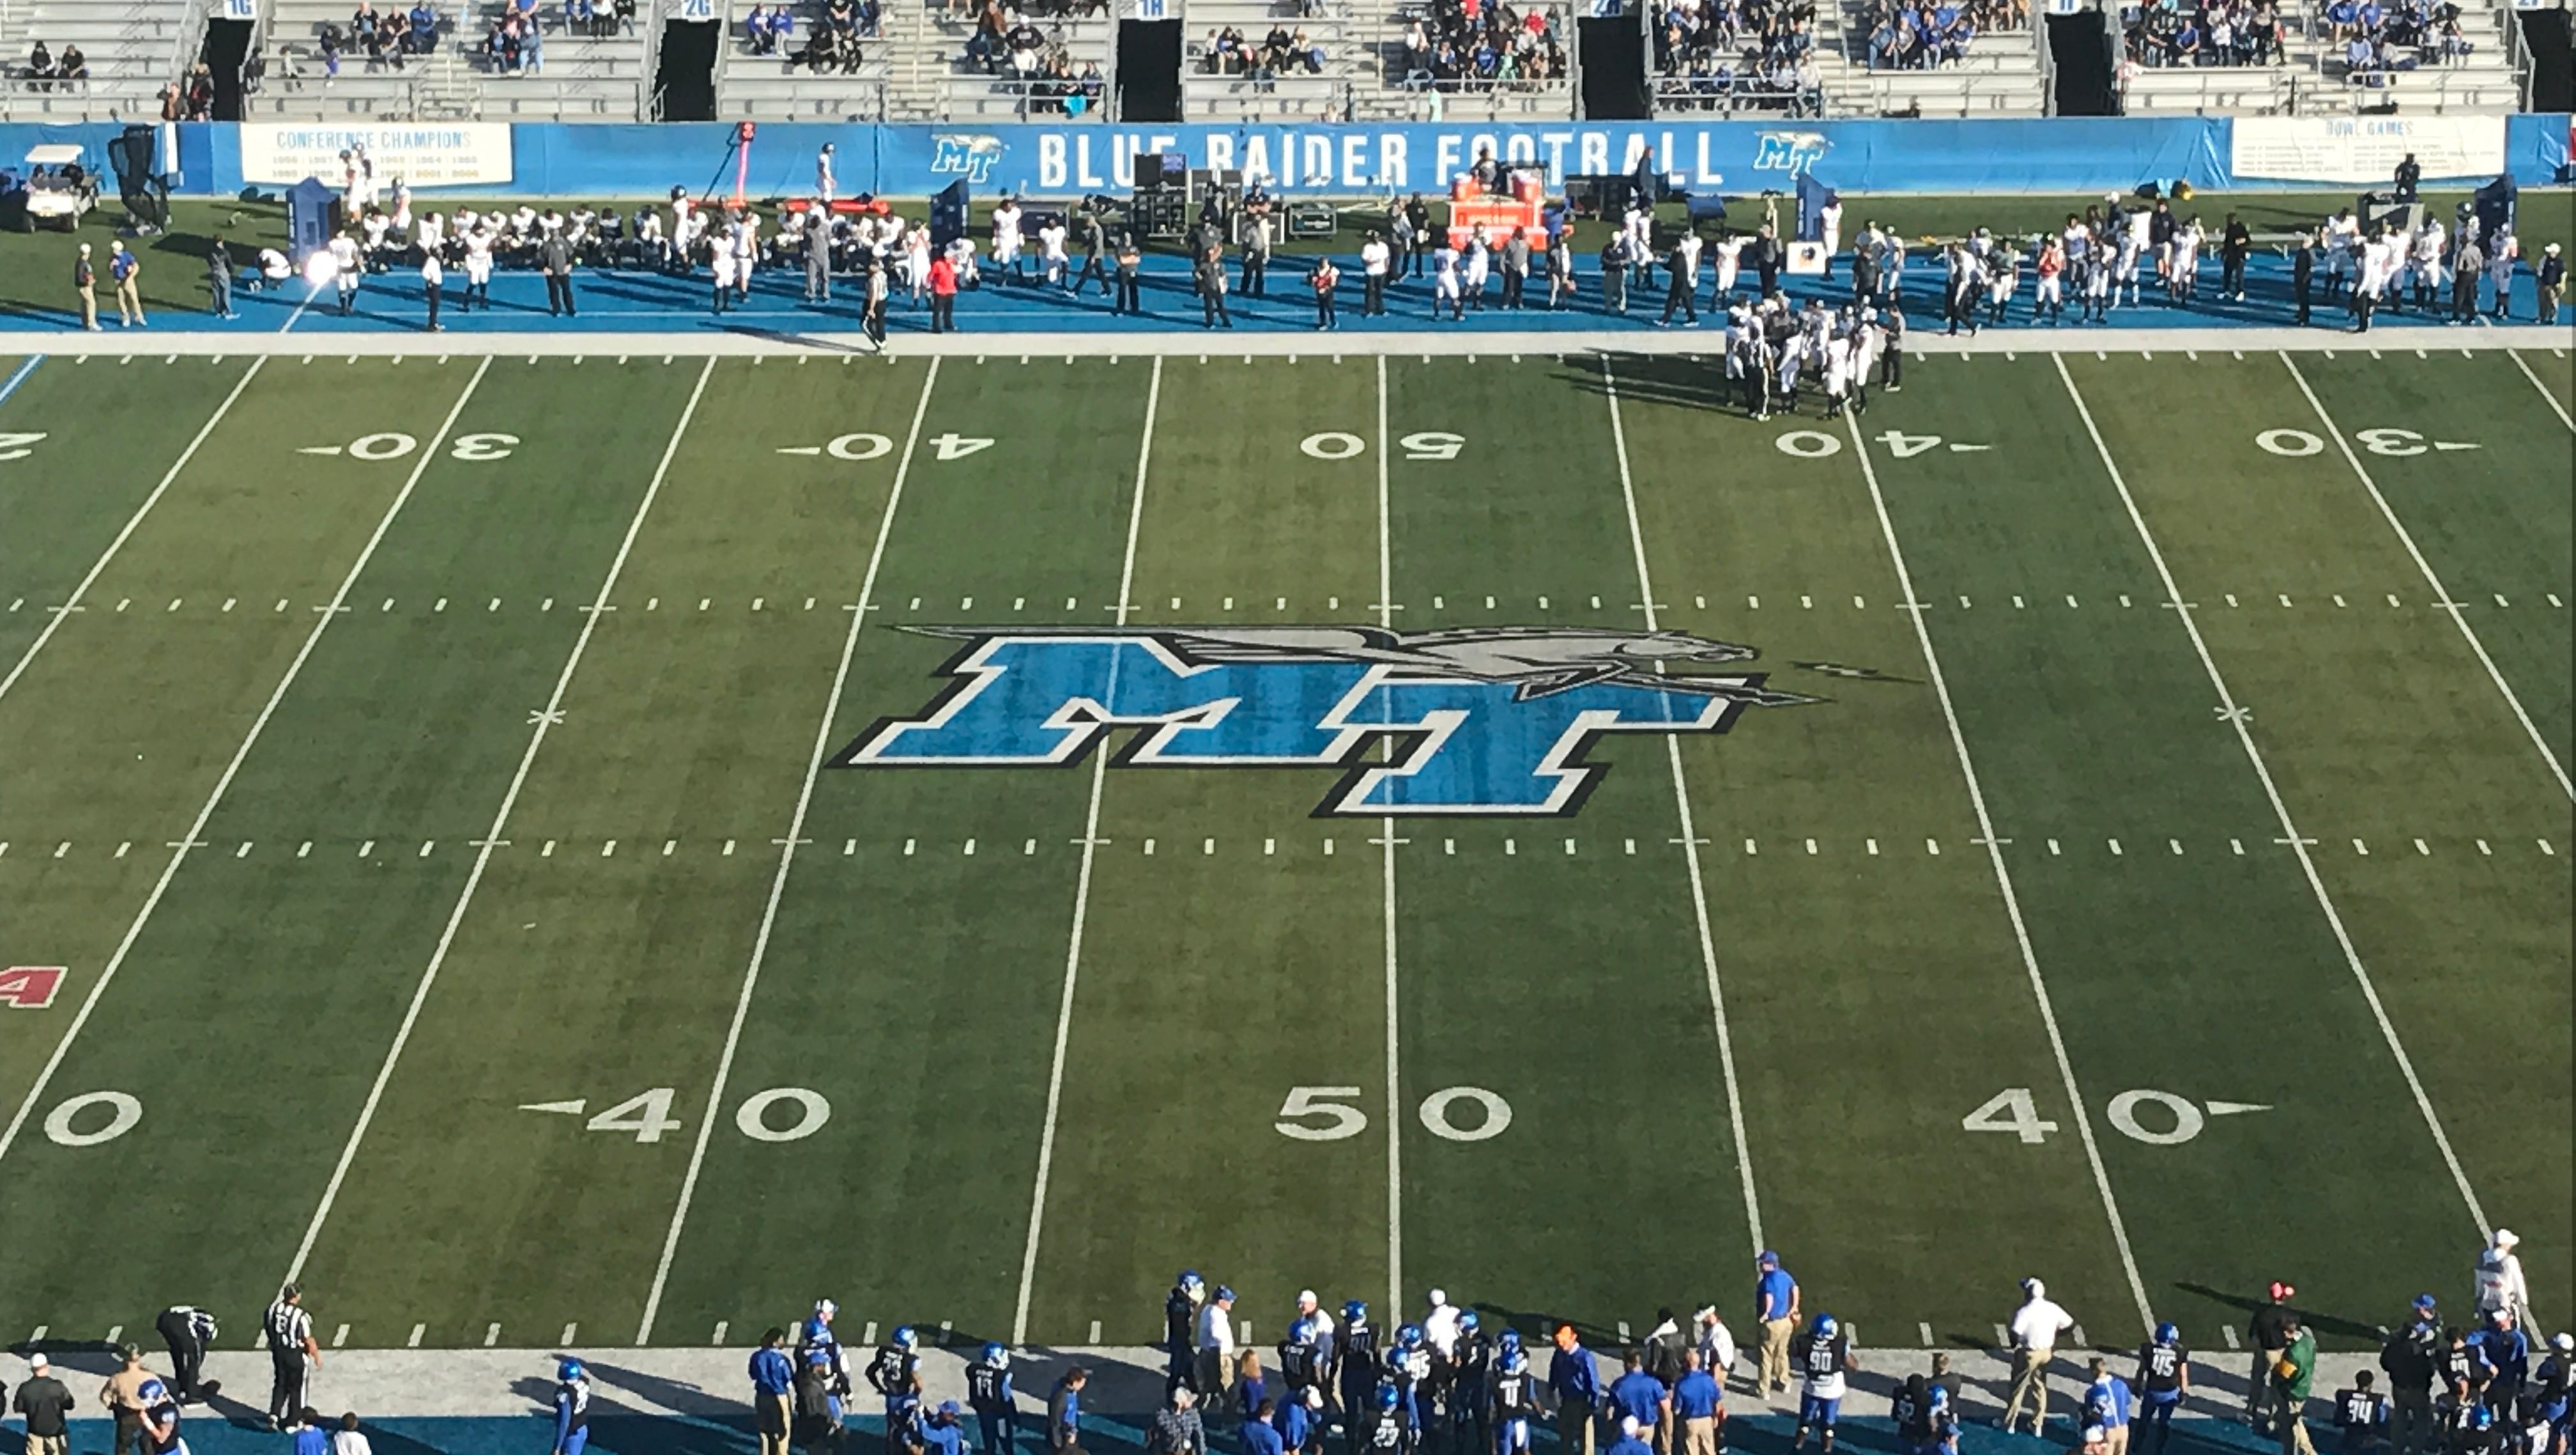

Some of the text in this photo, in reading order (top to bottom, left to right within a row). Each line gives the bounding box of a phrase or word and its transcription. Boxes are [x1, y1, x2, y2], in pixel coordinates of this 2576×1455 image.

[277, 131, 471, 149] CONFERENCE CHAMPIONS
[2366, 120, 2414, 136] GAMES
[1206, 133, 1407, 188] RAIDER
[827, 632, 1767, 818] MT
[1809, 1350, 1833, 1373] 90
[2151, 1353, 2177, 1378] 45
[2347, 1399, 2374, 1425] 34
